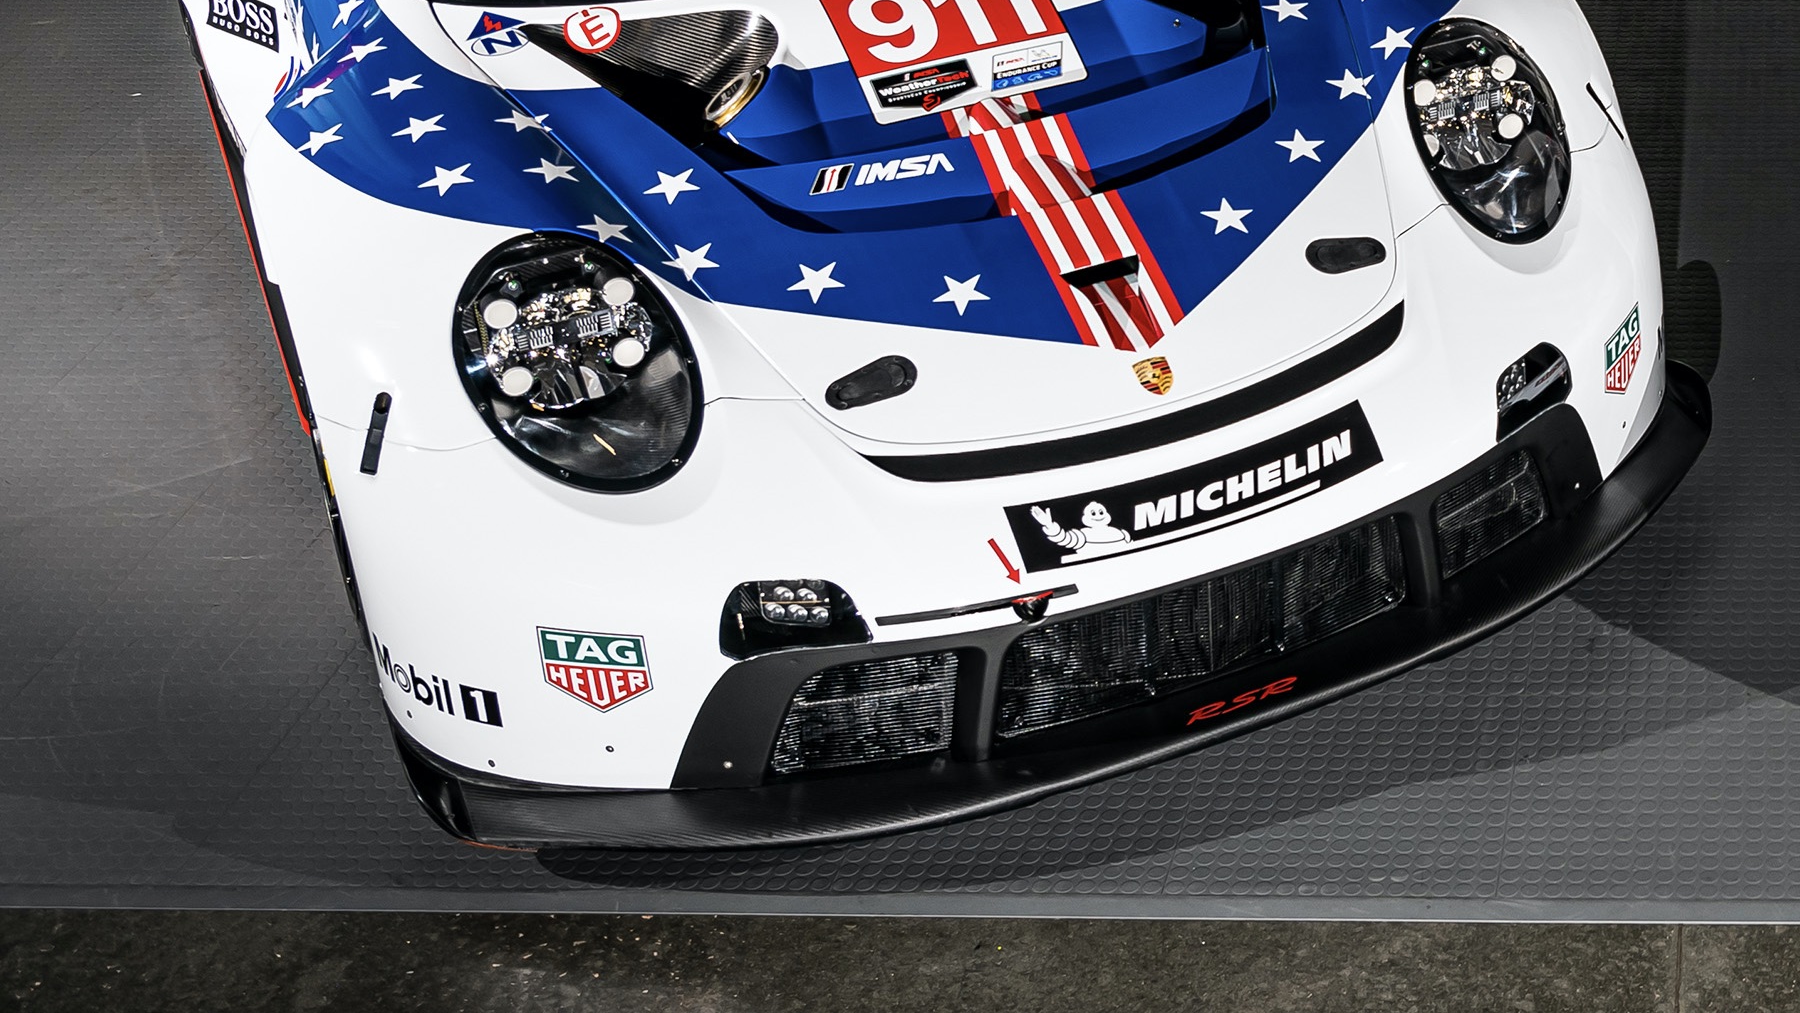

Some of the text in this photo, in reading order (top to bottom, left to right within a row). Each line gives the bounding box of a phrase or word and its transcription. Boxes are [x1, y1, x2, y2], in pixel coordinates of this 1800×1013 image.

[212, 16, 274, 45] HUGO BOSS
[879, 71, 969, 97] WeatherTech
[854, 152, 955, 186] IMSA
[1608, 311, 1638, 362] TAG
[1607, 337, 1640, 389] HEUER
[1134, 429, 1352, 531] MICHELIN
[545, 633, 638, 664] TAG
[372, 631, 455, 716] Mobil
[549, 665, 646, 706] HEUER
[1186, 676, 1297, 726] RSR
